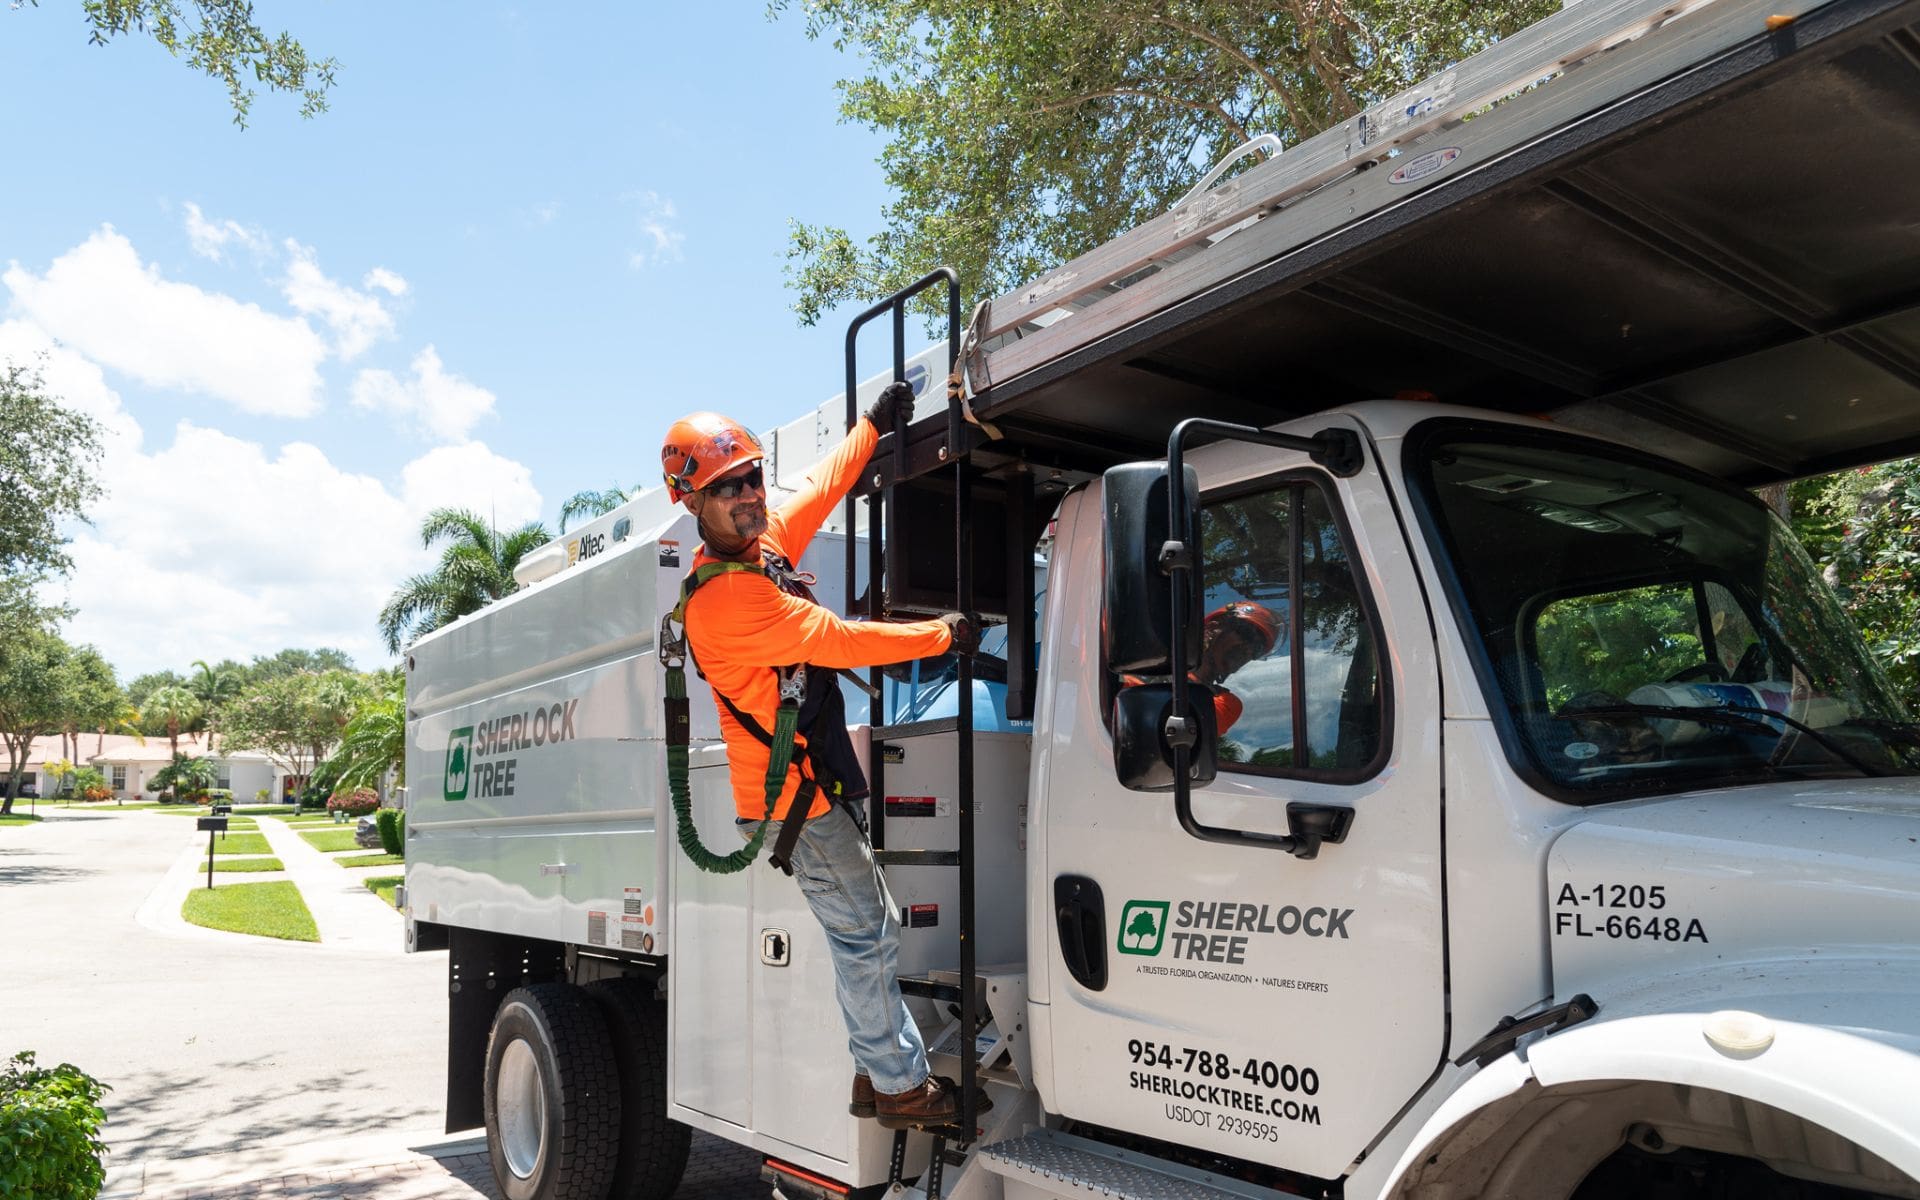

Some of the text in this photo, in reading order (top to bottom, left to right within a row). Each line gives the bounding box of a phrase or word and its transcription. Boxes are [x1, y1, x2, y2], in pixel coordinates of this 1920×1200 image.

[578, 532, 605, 561] Altec
[475, 699, 579, 757] SHERLOCK
[473, 758, 517, 799] TREE
[1556, 883, 1666, 909] A-1205
[1175, 900, 1355, 939] SHERLOCK
[1556, 913, 1709, 943] FL-6648A
[1171, 932, 1249, 965] TREE
[1136, 966, 1329, 993] A TRUSTED FLORIDA ORGANIZATION NATURES EXPERTS
[1128, 1039, 1320, 1096] 954-788-4000
[1129, 1072, 1321, 1126] SHERLOCKTREE.COM
[1165, 1103, 1279, 1143] USDOT 2939595
